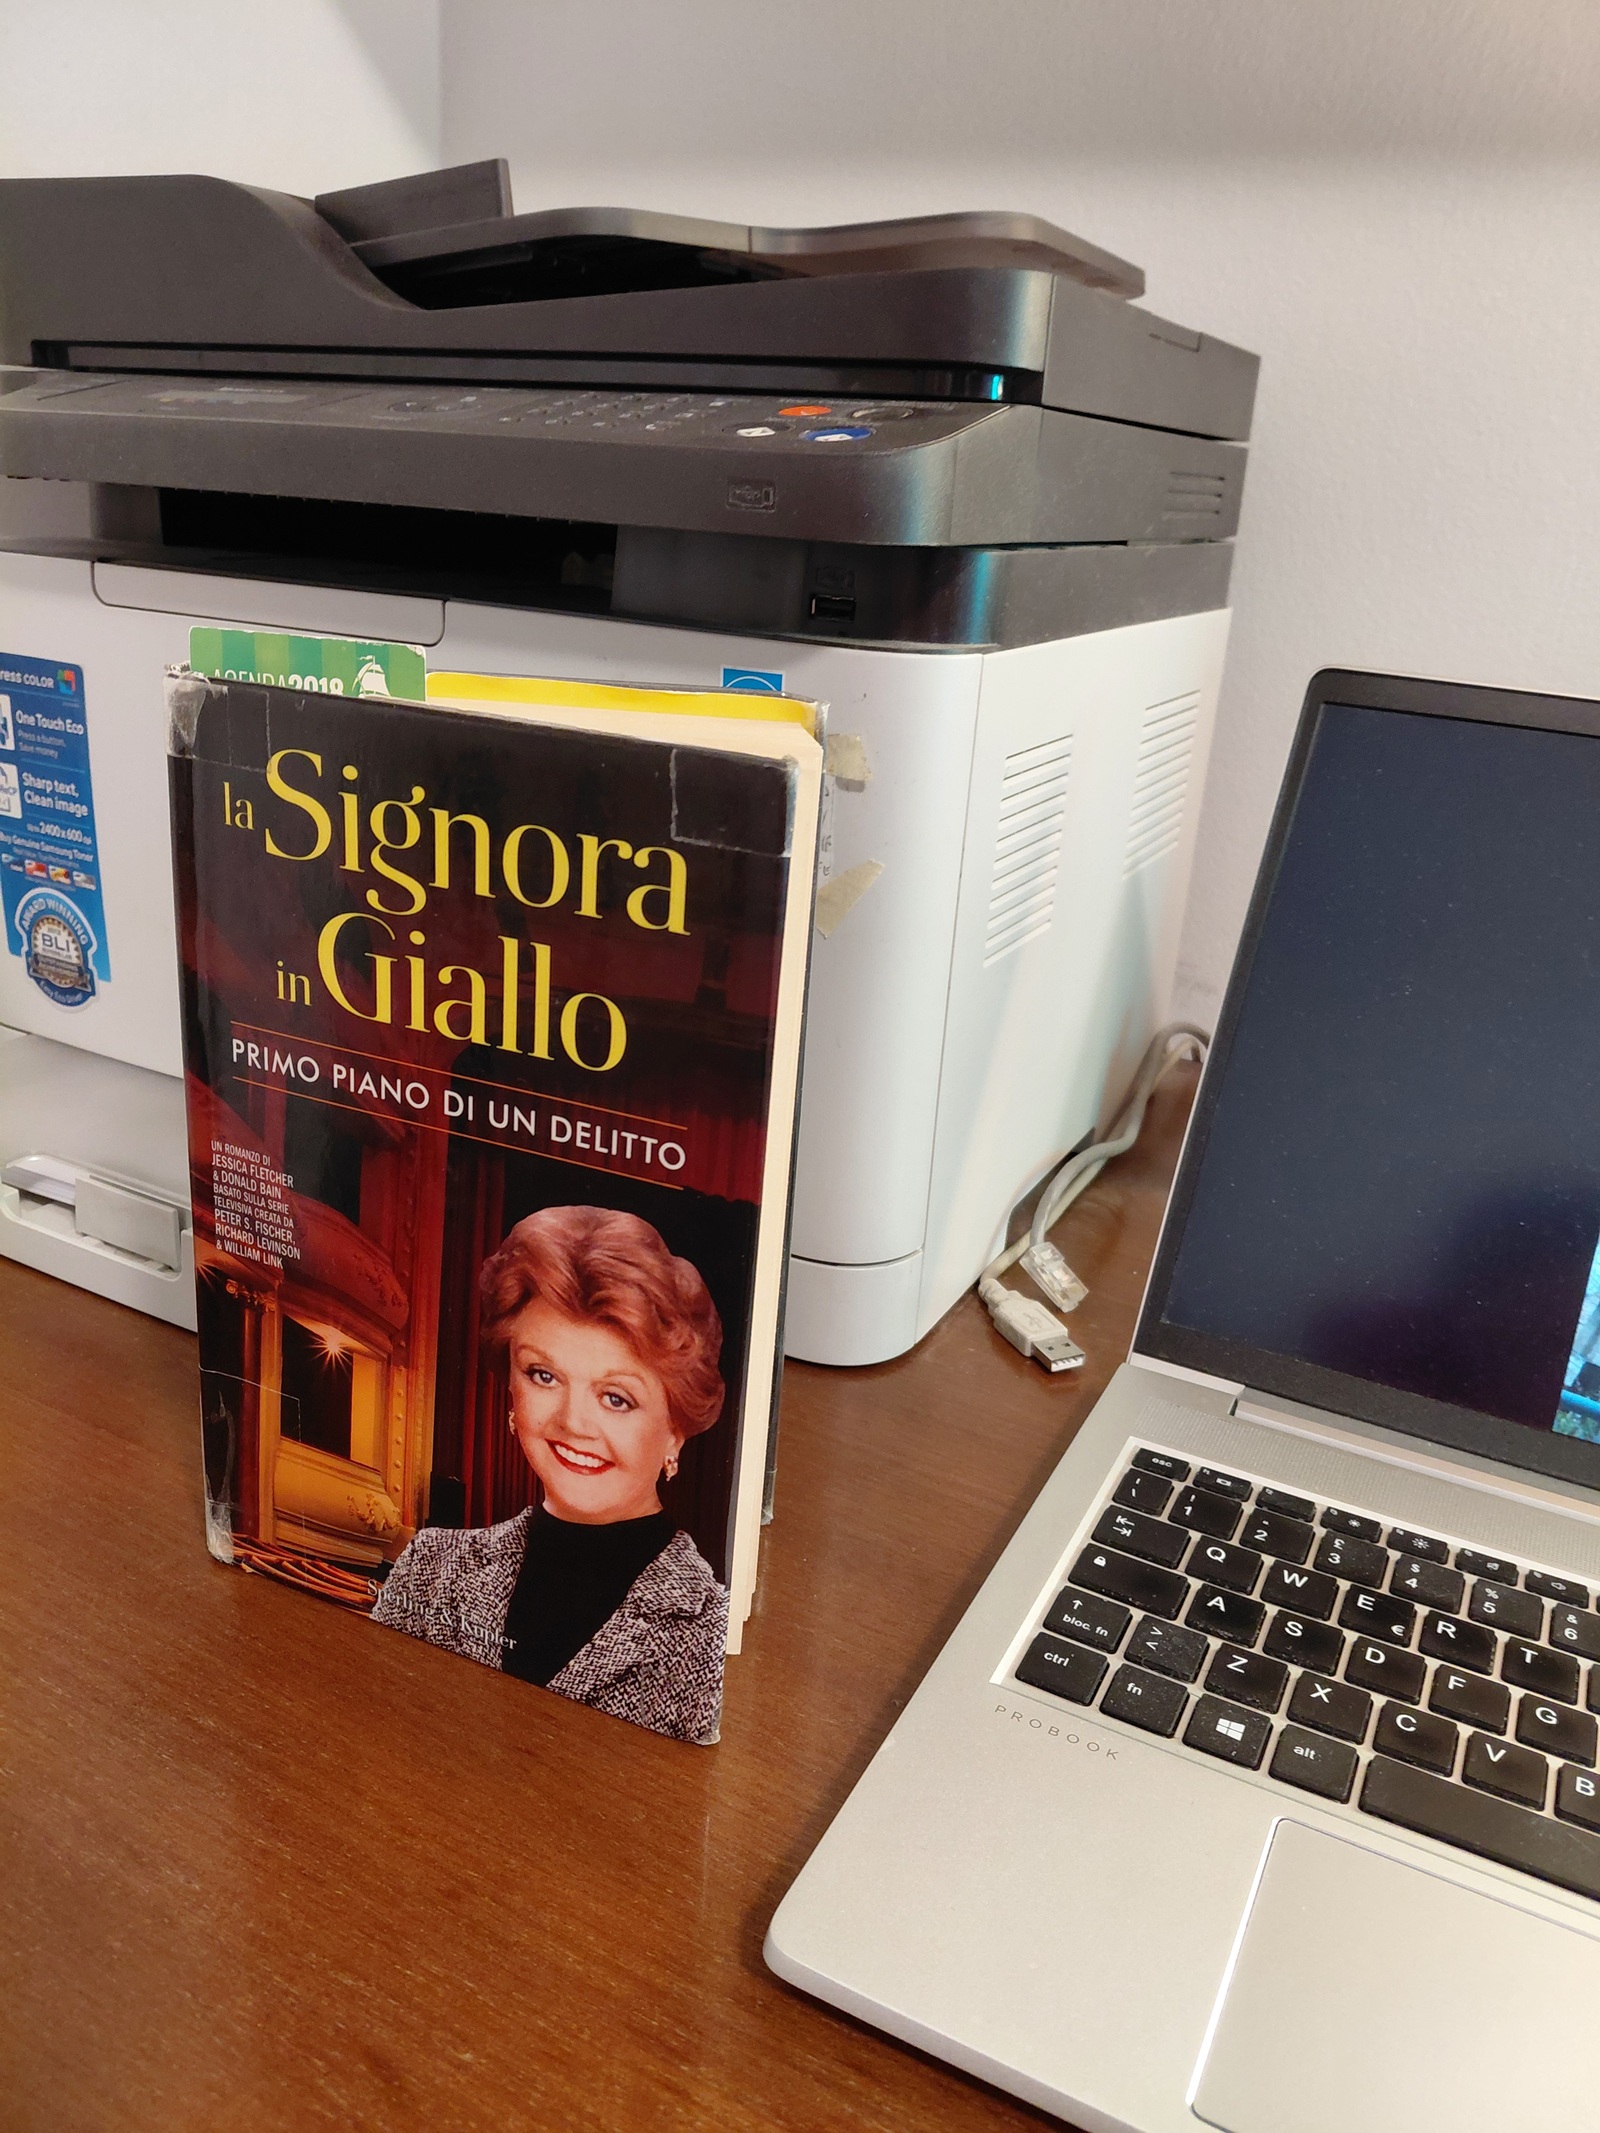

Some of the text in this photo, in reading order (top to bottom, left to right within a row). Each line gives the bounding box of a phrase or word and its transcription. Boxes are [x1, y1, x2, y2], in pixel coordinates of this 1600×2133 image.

[23, 674, 54, 688] COLOR
[16, 710, 84, 735] One Touch Eco
[22, 772, 53, 793] Sharp
[24, 790, 88, 818] Clean image
[222, 781, 254, 831] la
[264, 748, 691, 936] Signora
[42, 933, 70, 952] BLI
[276, 912, 628, 1072] in Giallo
[231, 1038, 687, 1171] PRIMO PIANO DI UN DELITTO
[211, 1140, 270, 1166] UN ROMANZO DI
[212, 1153, 294, 1188] JESSICA FLETCHER
[213, 1170, 282, 1200] & DONALD BAIN
[213, 1182, 289, 1215] BASATO SULLA SERIE
[214, 1196, 294, 1229] TELEVISIVA CREATA DA
[214, 1209, 296, 1245] PETER S. FISCHER,
[216, 1224, 301, 1260] RICHARD LEVINSON
[216, 1239, 284, 1270] & WILLIAM LINK
[1152, 1457, 1172, 1468] esc
[1184, 1505, 1192, 1516] 1
[1254, 1529, 1268, 1542] 2
[1206, 1546, 1227, 1564] Q
[1328, 1552, 1341, 1565] 3
[1282, 1569, 1308, 1588] W
[1405, 1578, 1418, 1589] 4
[1356, 1594, 1376, 1612] E
[1485, 1588, 1499, 1600] %
[1206, 1596, 1226, 1612] A
[1482, 1602, 1496, 1614] 5
[440, 1610, 453, 1628] &
[1566, 1614, 1578, 1624] &
[1095, 1626, 1109, 1637] fn
[1284, 1620, 1304, 1637] S
[1390, 1625, 1406, 1637] €
[1436, 1620, 1457, 1640] R
[1564, 1628, 1578, 1640] 6
[1043, 1652, 1070, 1667] ctrl
[1226, 1654, 1248, 1674] Z
[1364, 1646, 1386, 1664] D
[1520, 1646, 1538, 1664] T
[1126, 1682, 1142, 1696] fn
[1448, 1675, 1466, 1690] F
[1310, 1682, 1332, 1704] X
[1395, 1714, 1417, 1732] C
[1535, 1706, 1558, 1725] G
[994, 1704, 1120, 1760] PROBOOK
[1293, 1745, 1316, 1760] alt
[1484, 1742, 1507, 1763] V
[1575, 1776, 1596, 1797] B
